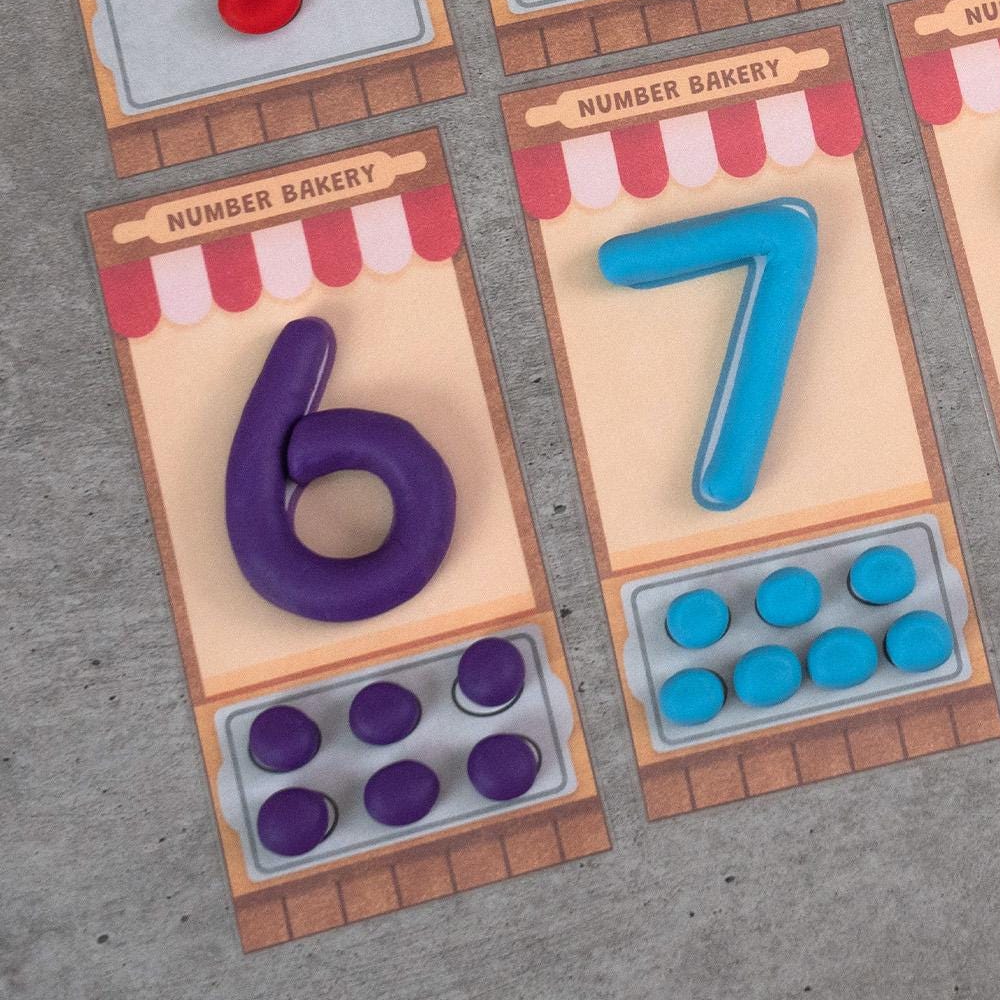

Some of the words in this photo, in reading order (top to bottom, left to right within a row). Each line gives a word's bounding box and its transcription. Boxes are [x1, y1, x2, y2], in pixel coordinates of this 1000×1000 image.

[577, 80, 681, 118] NUMBER
[687, 58, 780, 95] BAKERY
[166, 189, 273, 233] NUMBER
[280, 163, 375, 204] BAKERY
[598, 197, 817, 512] 7
[225, 316, 456, 622] 6
